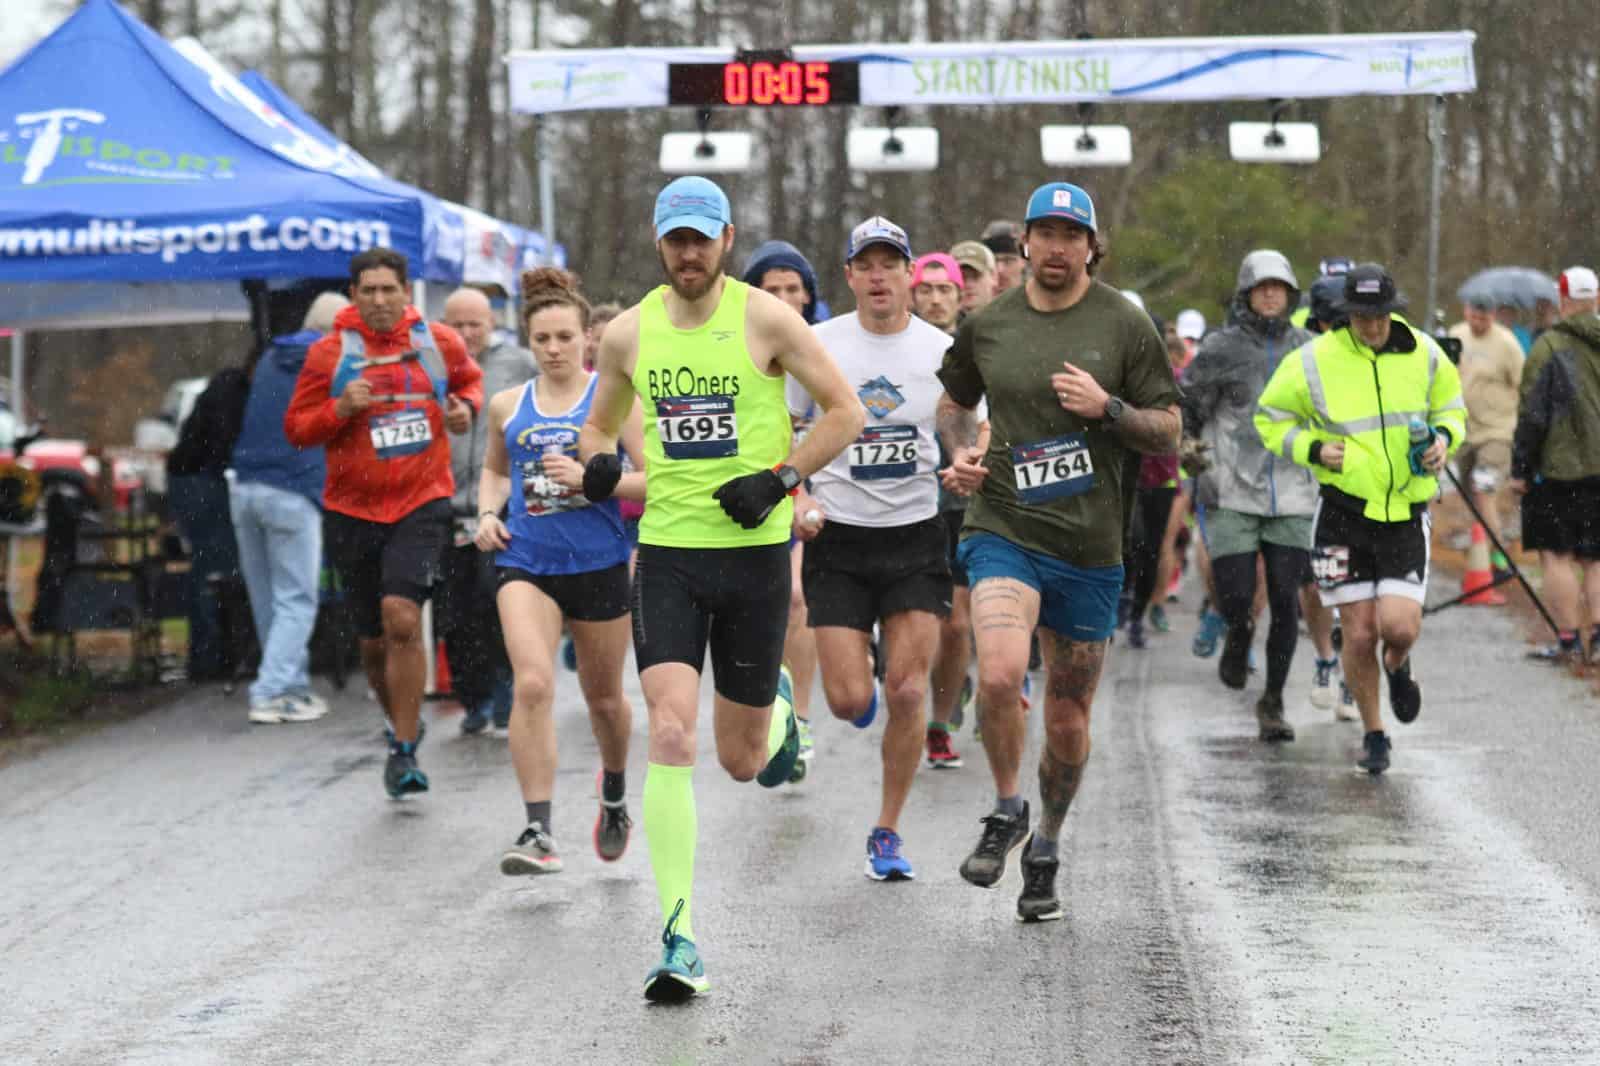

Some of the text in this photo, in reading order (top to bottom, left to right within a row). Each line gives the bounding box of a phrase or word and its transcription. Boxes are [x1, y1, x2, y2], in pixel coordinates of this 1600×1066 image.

[724, 62, 830, 105] 00:05
[912, 57, 1111, 97] START/FINISH
[0, 214, 391, 263] multisport.com
[648, 366, 740, 400] BROners
[378, 423, 427, 447] 1749
[661, 415, 734, 441] 1695
[853, 442, 916, 465] 1726
[1018, 452, 1089, 487] 1764
